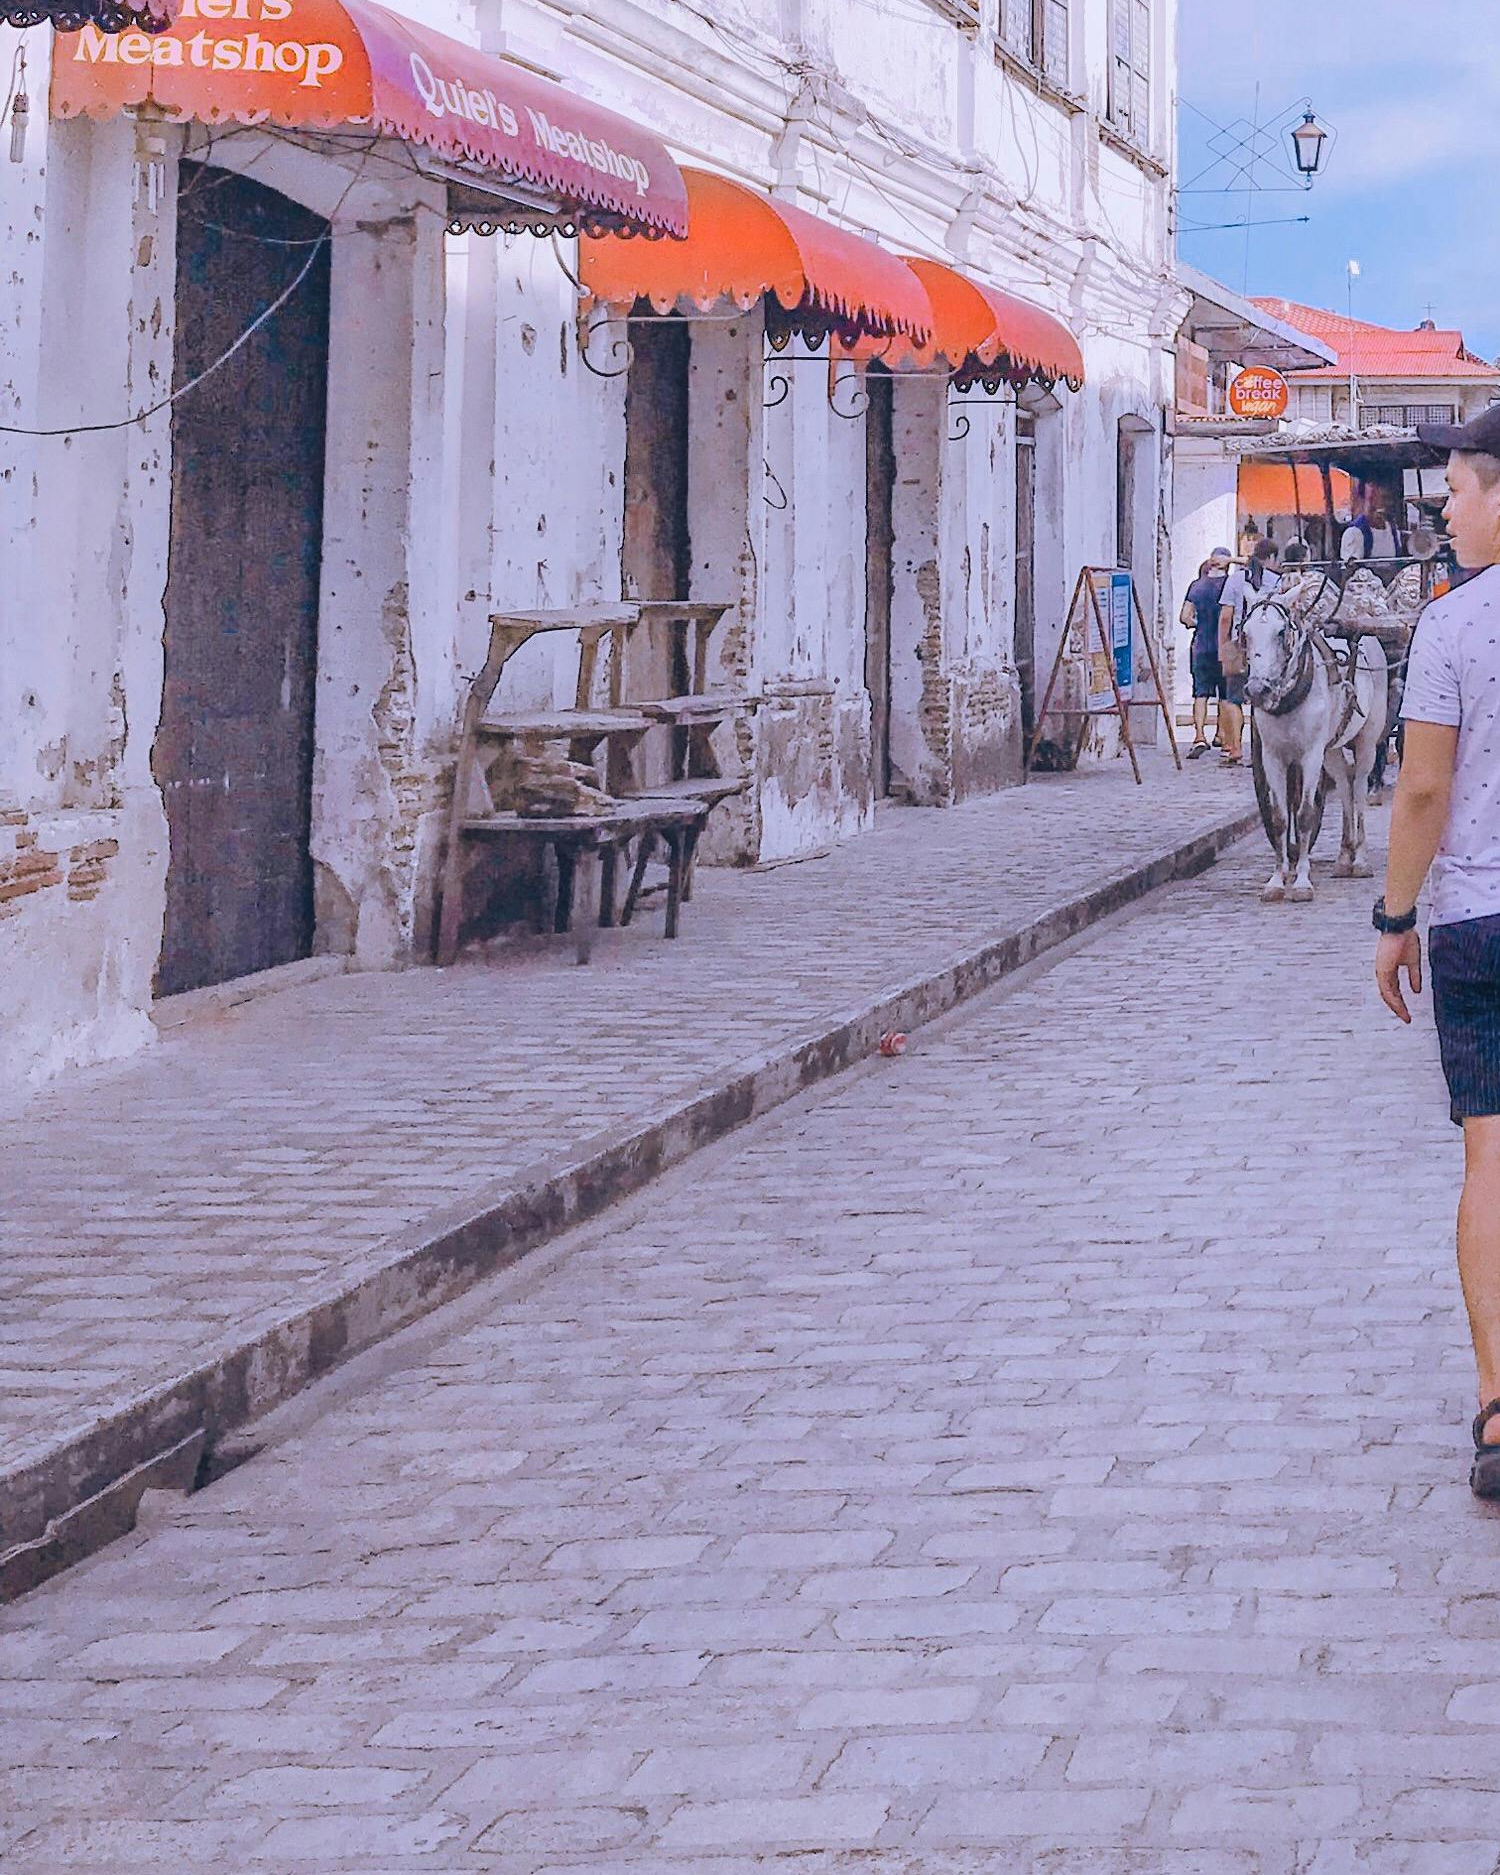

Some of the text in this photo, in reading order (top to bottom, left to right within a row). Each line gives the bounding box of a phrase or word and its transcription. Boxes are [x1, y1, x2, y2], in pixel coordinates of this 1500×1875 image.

[73, 24, 343, 87] Meatshop
[409, 52, 650, 197] Quiel's Meatshop
[1234, 374, 1283, 389] coffee
[1236, 389, 1281, 400] break
